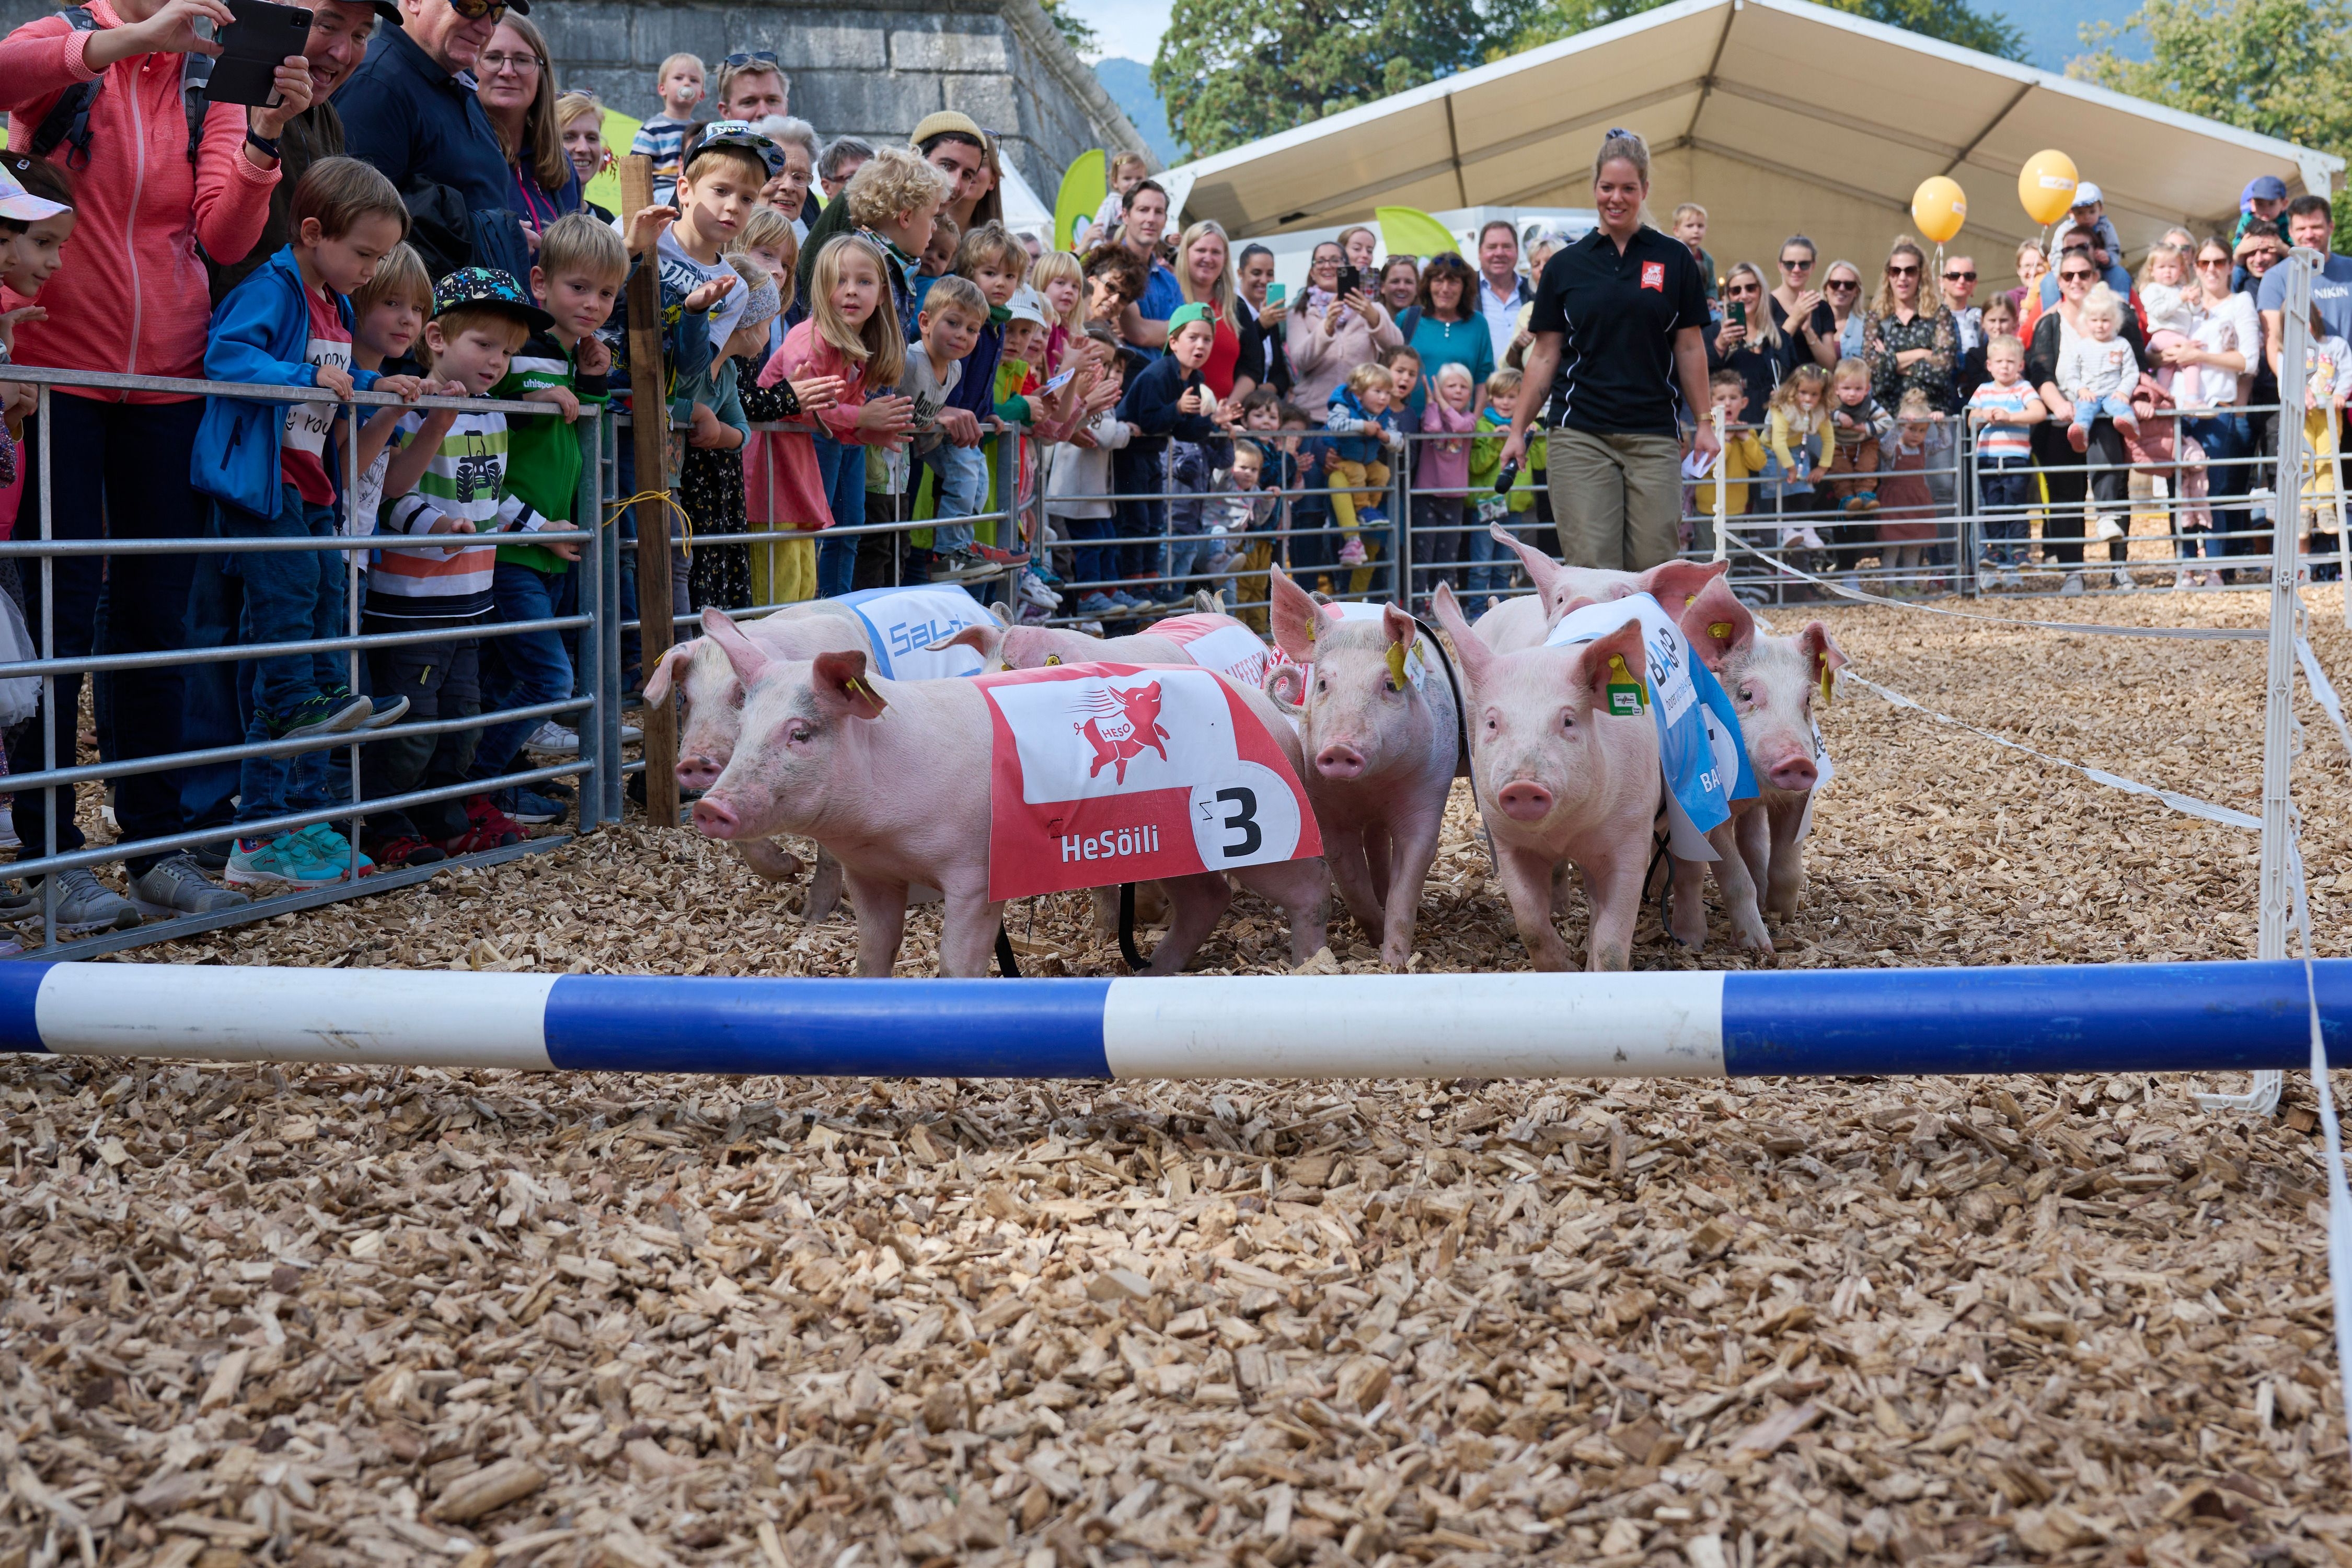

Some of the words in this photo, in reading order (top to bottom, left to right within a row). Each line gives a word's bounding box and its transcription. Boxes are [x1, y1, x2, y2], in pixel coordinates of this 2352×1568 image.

[2314, 286, 2349, 299] NIKIN
[304, 414, 328, 435] YOU
[1101, 723, 1130, 738] HESO
[1700, 765, 1722, 792] BA
[1216, 787, 1262, 857] 3
[1062, 825, 1159, 862] HeSöili
